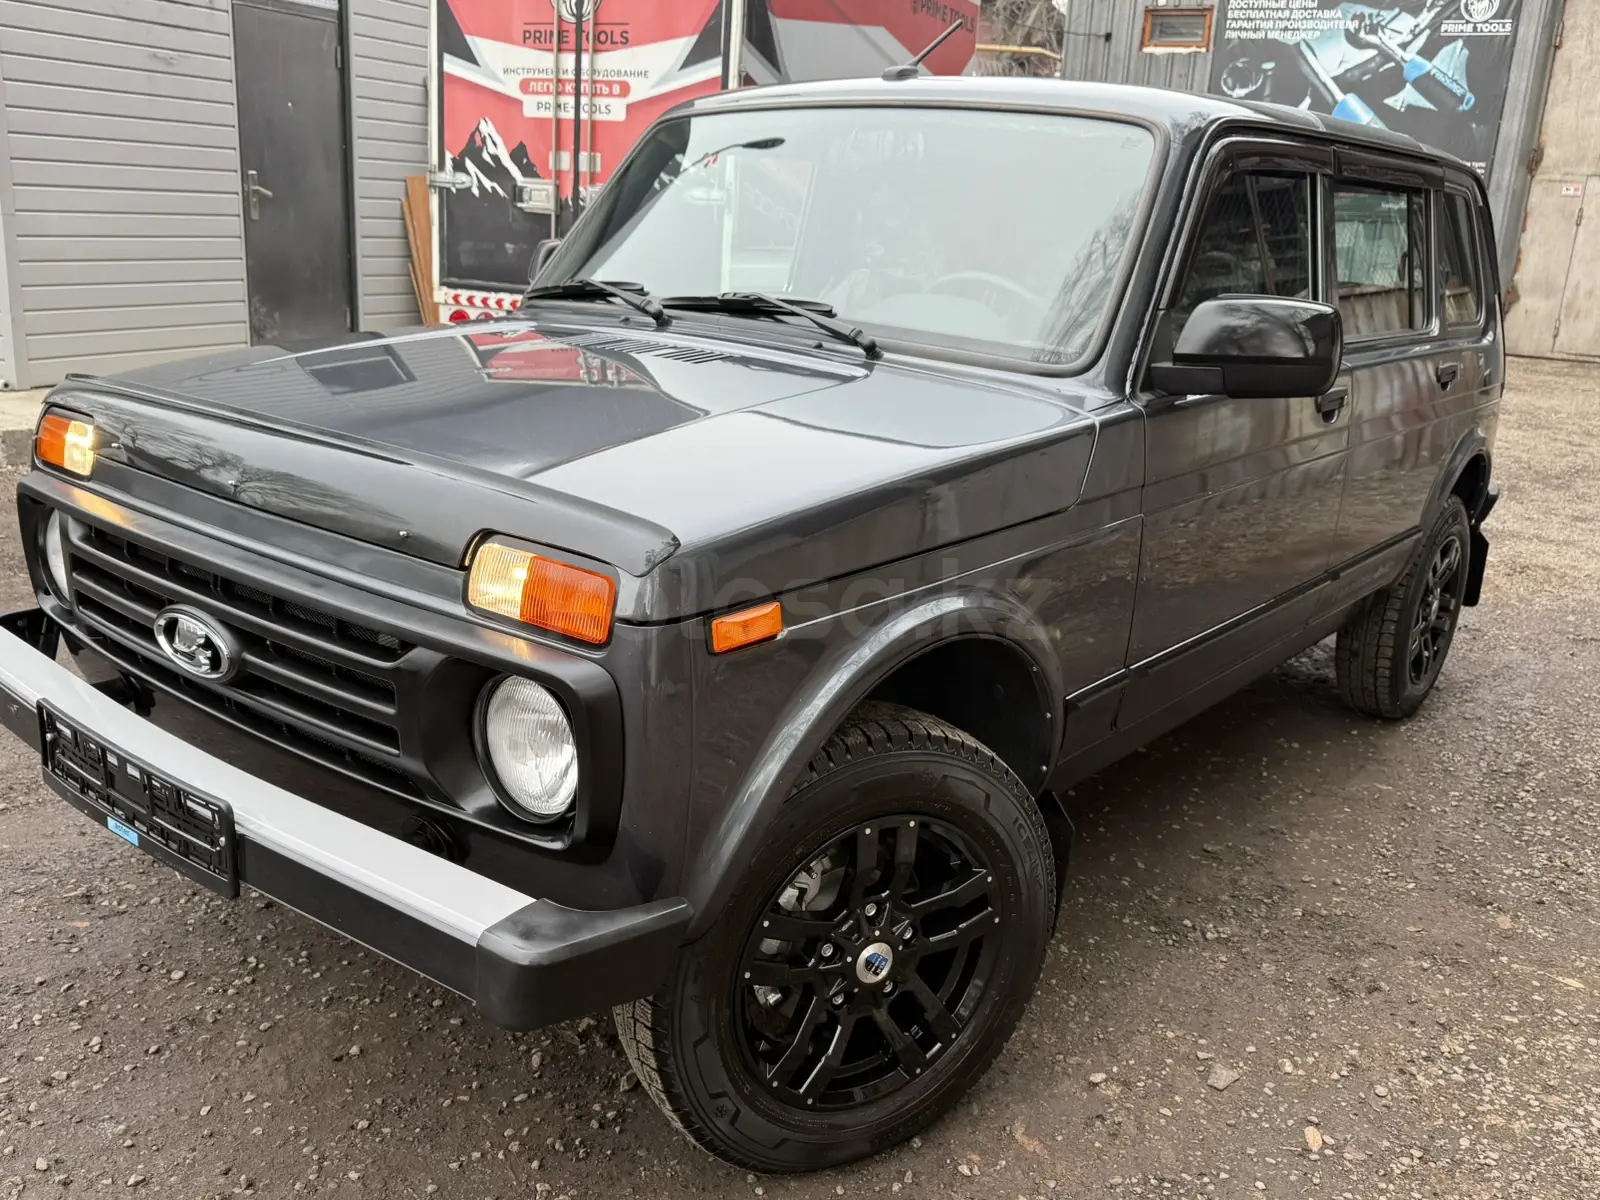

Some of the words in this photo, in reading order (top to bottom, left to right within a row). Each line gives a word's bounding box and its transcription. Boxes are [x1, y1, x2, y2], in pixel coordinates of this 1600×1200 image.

[1228, 0, 1287, 9] ДОСТУПНЫЕ
[1289, 0, 1318, 9] ЦЕНЫ
[1227, 9, 1289, 19] БЕСПЛАТНАЯ
[1291, 9, 1343, 19] ДОСТАВКА
[1226, 19, 1274, 30] ГАРАНТИЯ
[1275, 19, 1359, 30] ПРОИЗВОДИТЕЛЯ
[1440, 23, 1475, 33] PRIME
[1476, 23, 1512, 32] TOOLS
[522, 29, 570, 45] PRIME
[1224, 30, 1266, 39] ЛИЧНЫЙ
[1267, 30, 1320, 40] МЕНЕДЖЕР
[561, 68, 569, 77] И
[611, 84, 621, 95] В
[536, 101, 612, 115] PRME-OOLS
